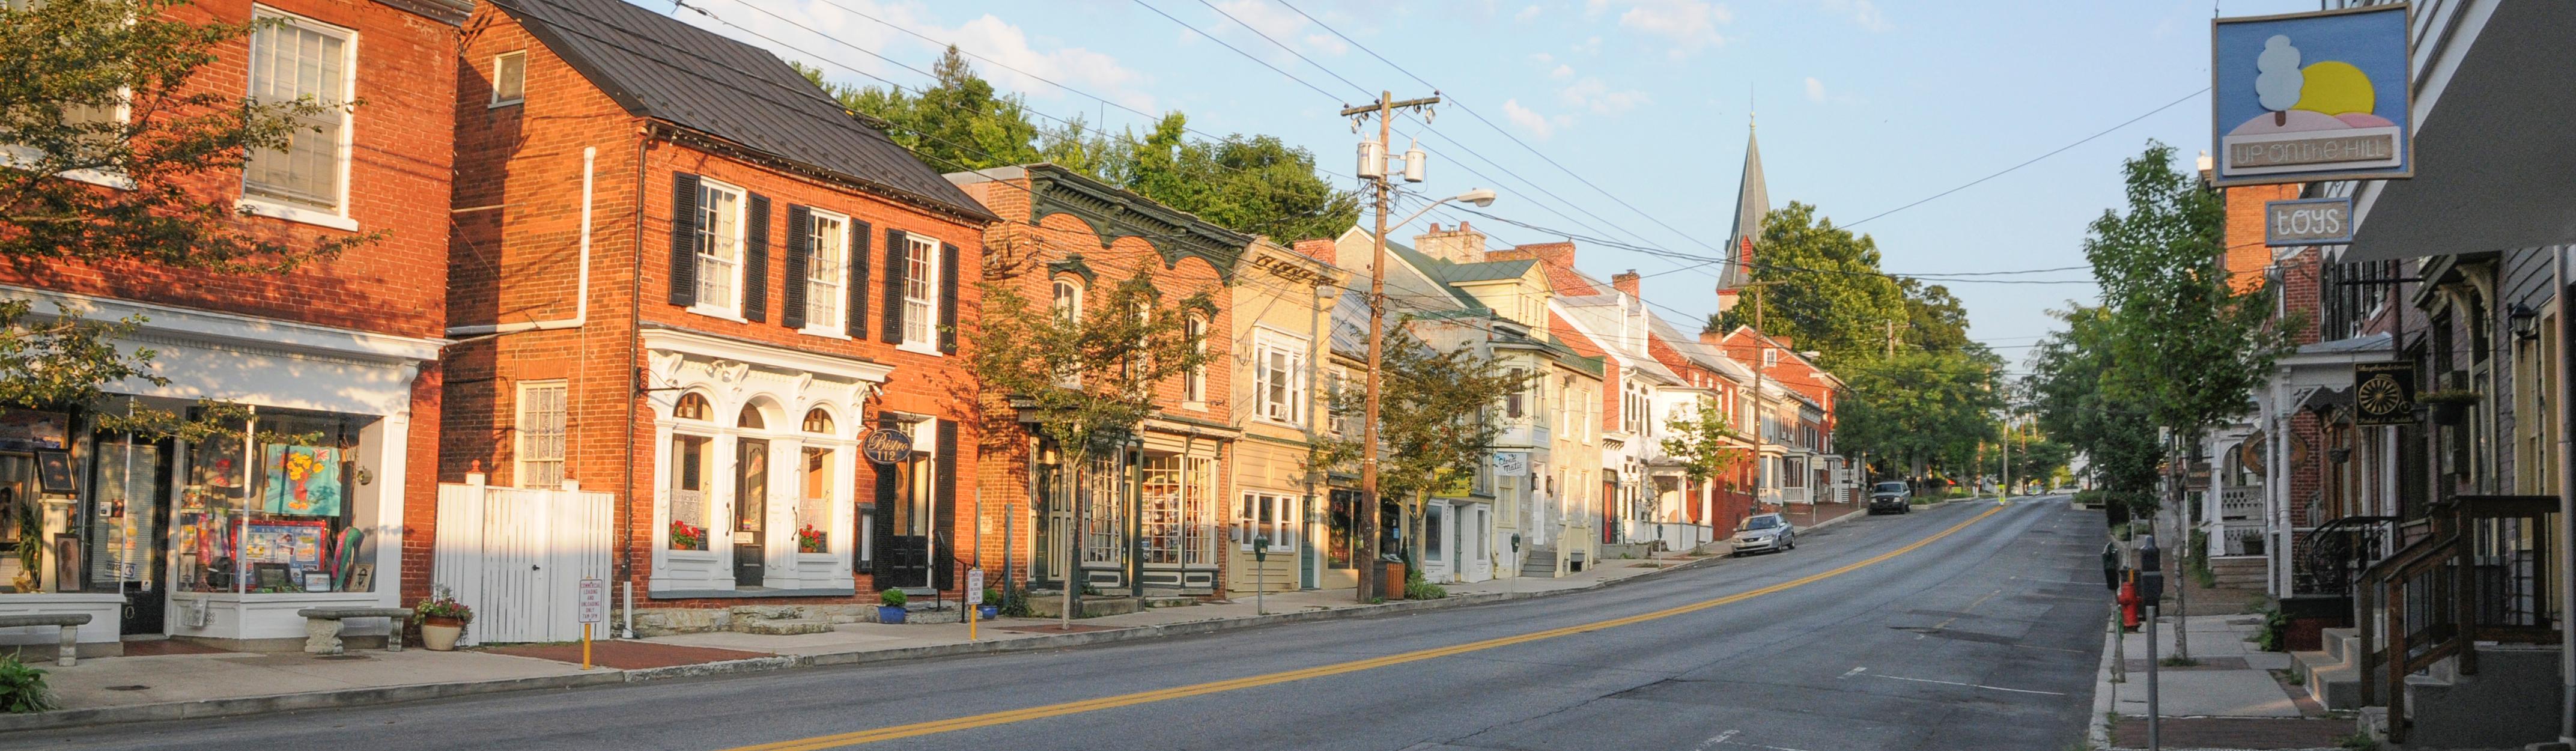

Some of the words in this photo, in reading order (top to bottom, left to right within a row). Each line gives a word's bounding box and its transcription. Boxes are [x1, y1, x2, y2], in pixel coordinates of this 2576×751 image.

[2237, 144, 2263, 164] UP
[2345, 139, 2385, 157] HILL
[867, 431, 908, 451] Bistro
[878, 451, 896, 461] 112
[1499, 457, 1516, 466] Cloud
